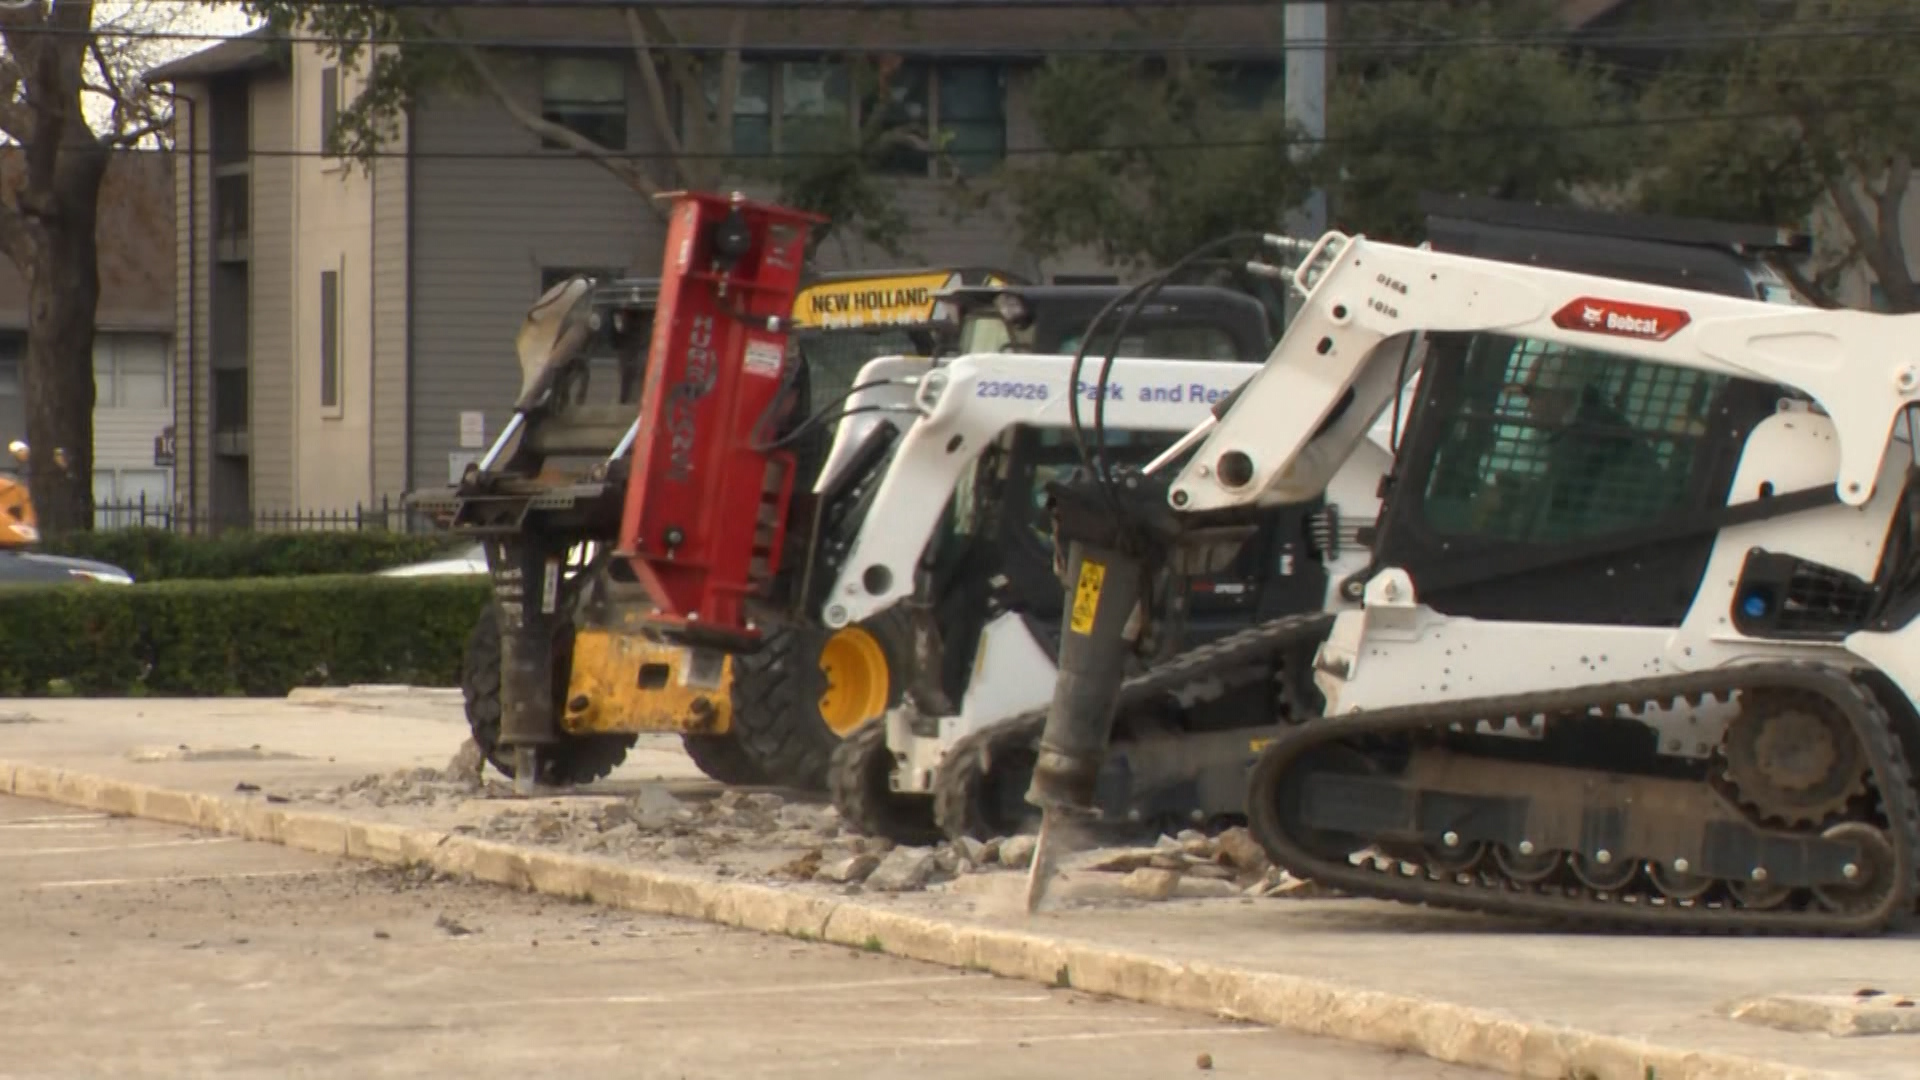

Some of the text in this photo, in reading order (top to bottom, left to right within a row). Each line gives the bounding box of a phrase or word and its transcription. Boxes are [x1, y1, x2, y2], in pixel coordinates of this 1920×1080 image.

[812, 287, 929, 313] NEW HOLLAND
[1606, 311, 1658, 334] Bobcat
[978, 381, 1048, 400] 239026
[1139, 383, 1182, 402] and
